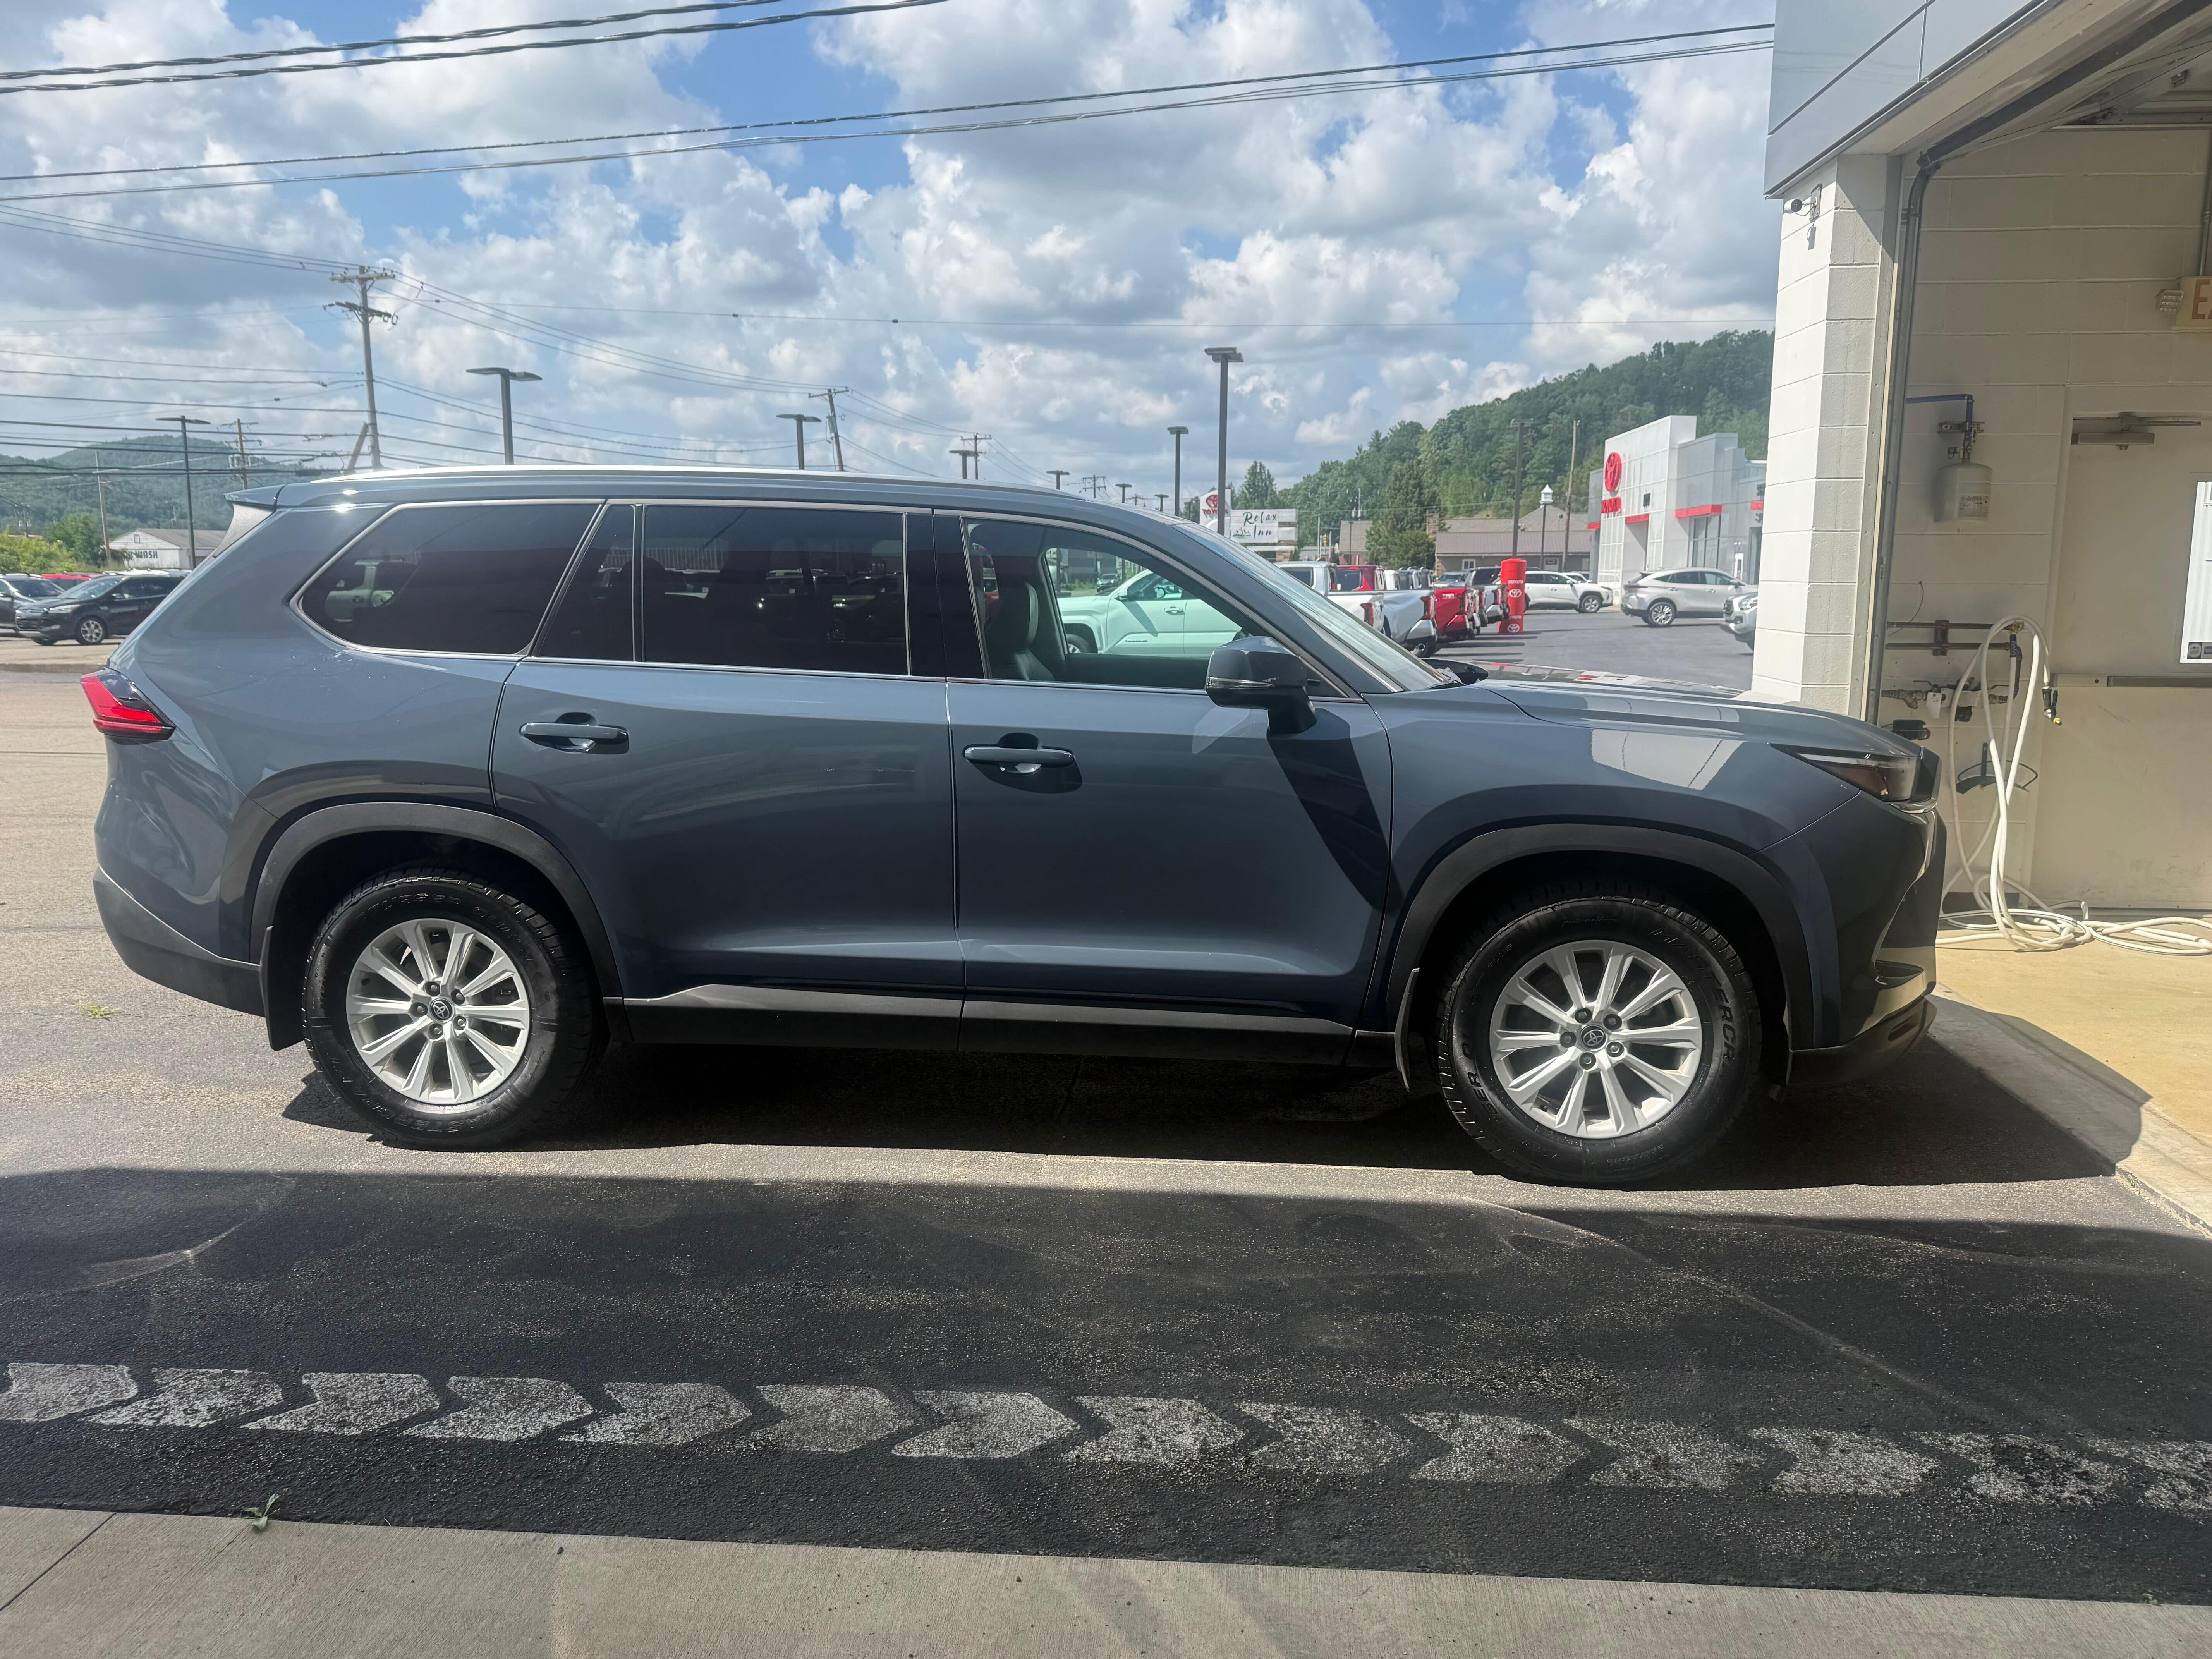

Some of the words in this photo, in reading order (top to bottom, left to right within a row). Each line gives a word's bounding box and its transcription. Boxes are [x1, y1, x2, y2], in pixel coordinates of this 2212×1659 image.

[1243, 512, 1277, 526] Relax
[1254, 525, 1273, 538] Inn
[136, 550, 158, 558] WASH
